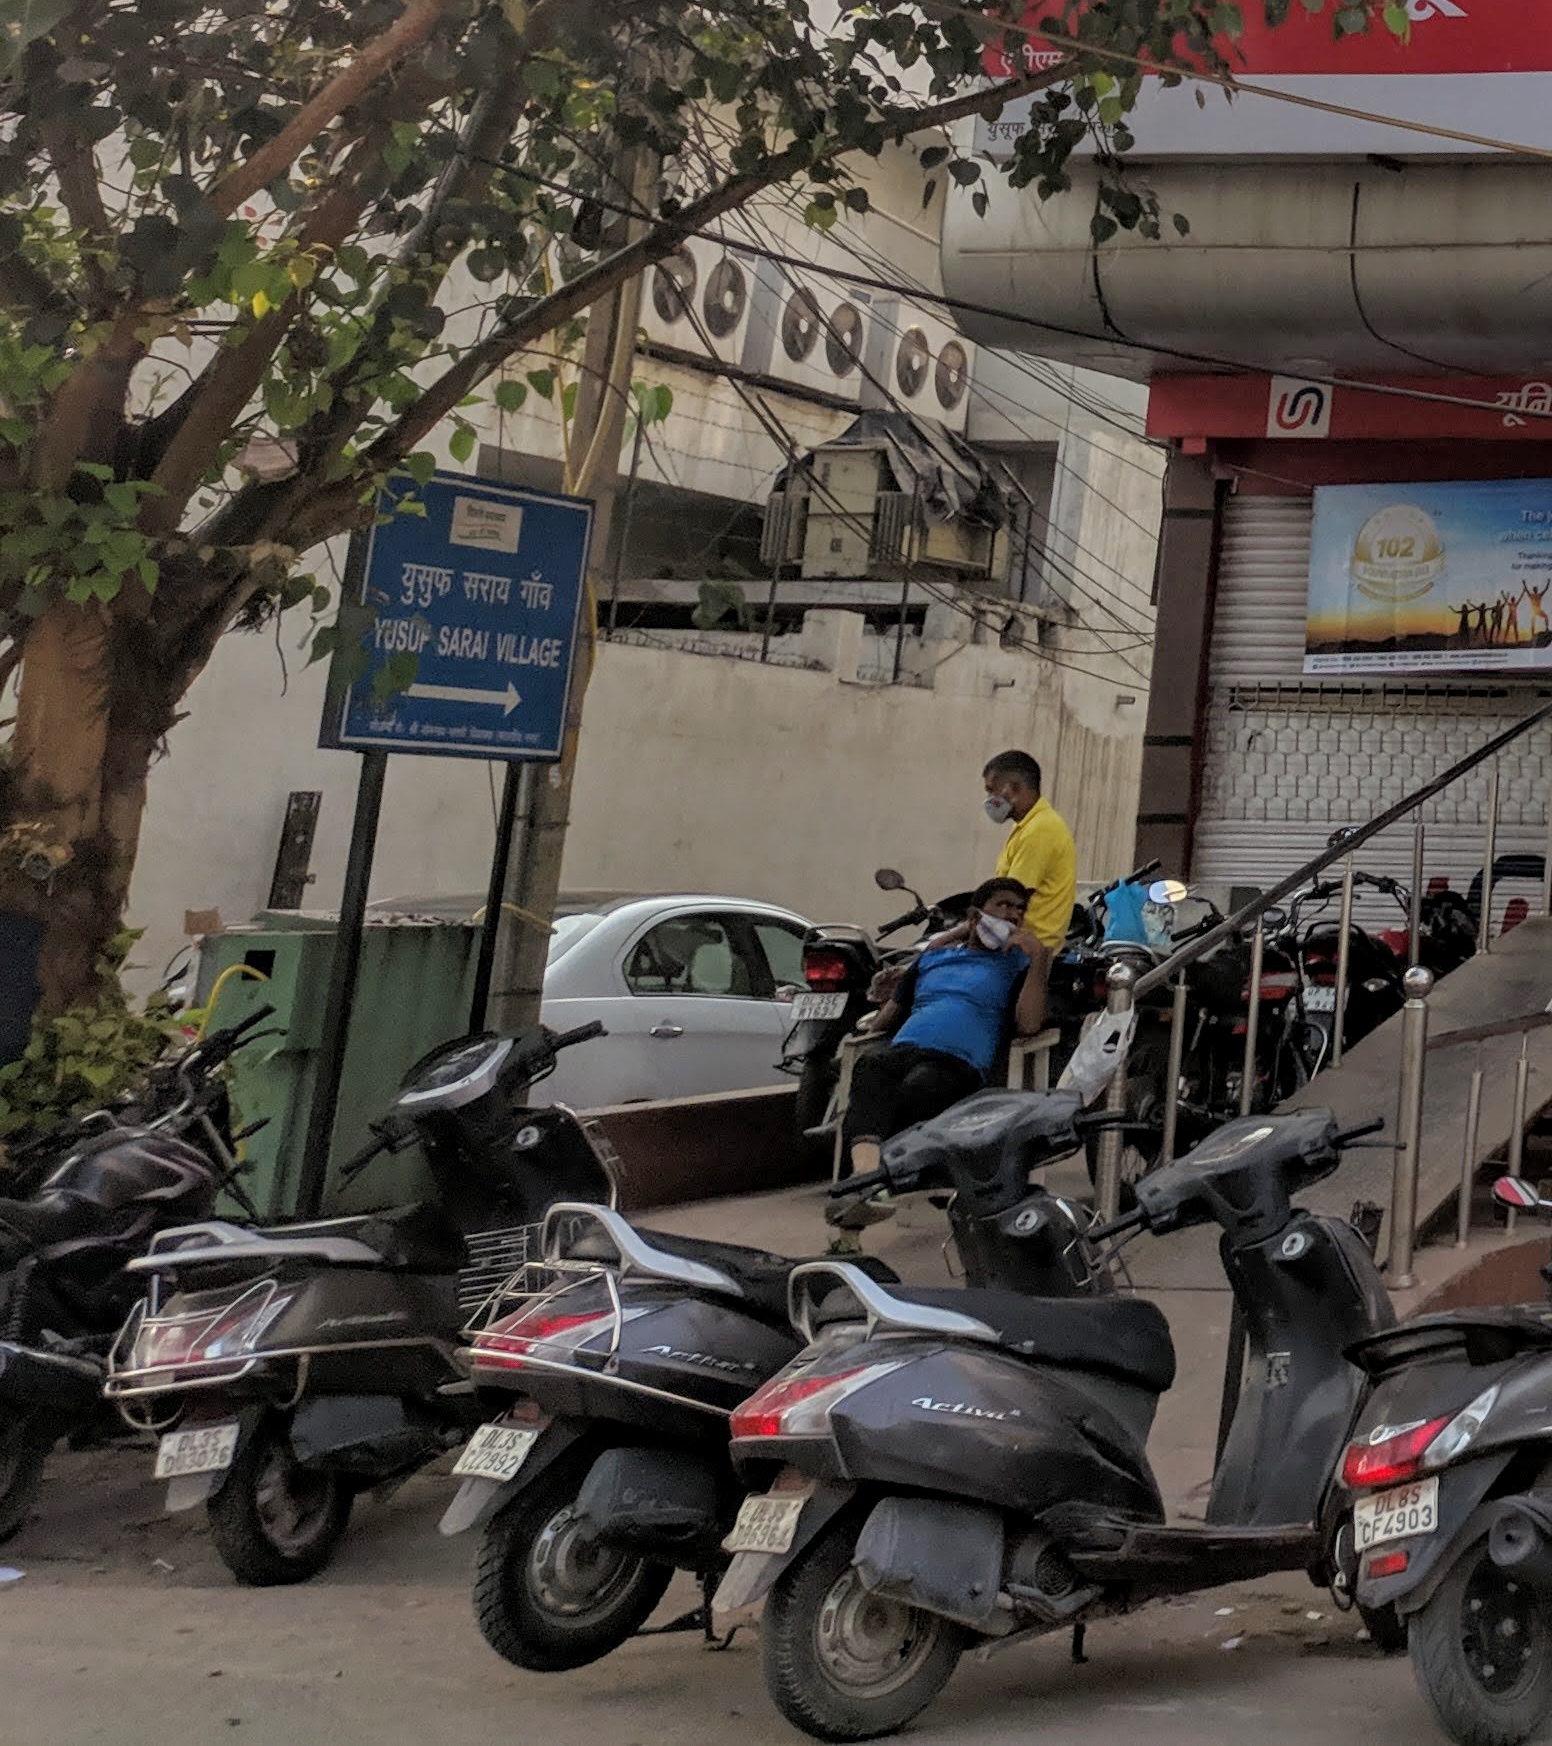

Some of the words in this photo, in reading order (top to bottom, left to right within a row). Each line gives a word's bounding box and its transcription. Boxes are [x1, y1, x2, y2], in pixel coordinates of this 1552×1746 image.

[1376, 537, 1416, 558] 102
[401, 563, 454, 607] युसुफ
[463, 571, 512, 604] सराय
[374, 618, 432, 654] YUSUF
[438, 626, 490, 661] SARAI
[496, 633, 563, 668] VILLAGE
[480, 1428, 523, 1451] DL3S
[1374, 1484, 1422, 1516] DL8S
[1362, 1506, 1433, 1543] CF4903
